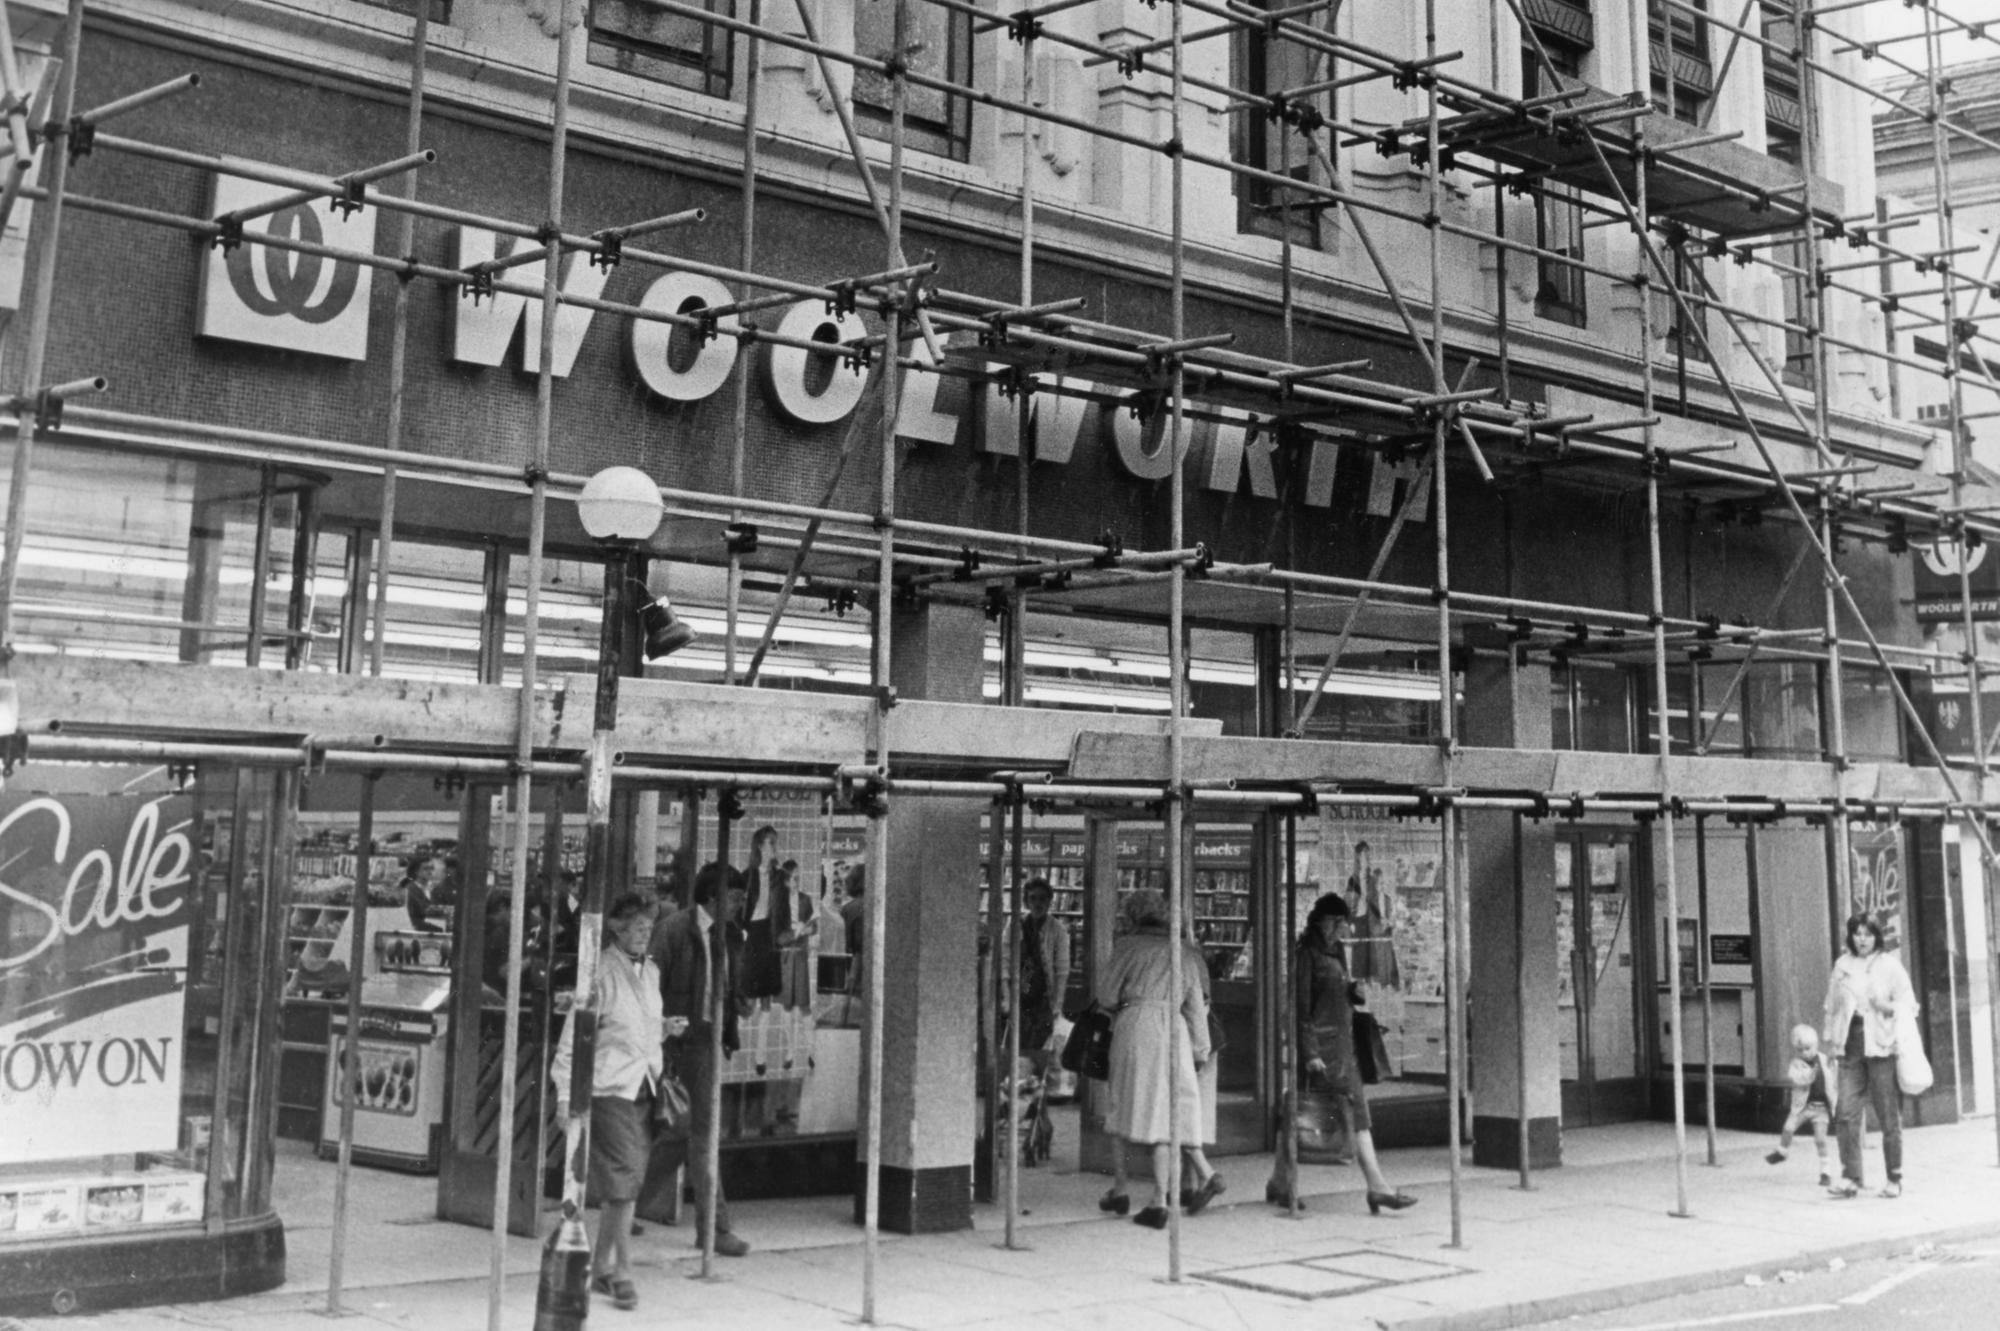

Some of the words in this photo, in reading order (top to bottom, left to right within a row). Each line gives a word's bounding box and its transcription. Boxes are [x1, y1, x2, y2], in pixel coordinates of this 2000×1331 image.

[1917, 601, 1998, 614] WOOLWRTH
[0, 798, 190, 967] Sale
[97, 1038, 172, 1086] ON
